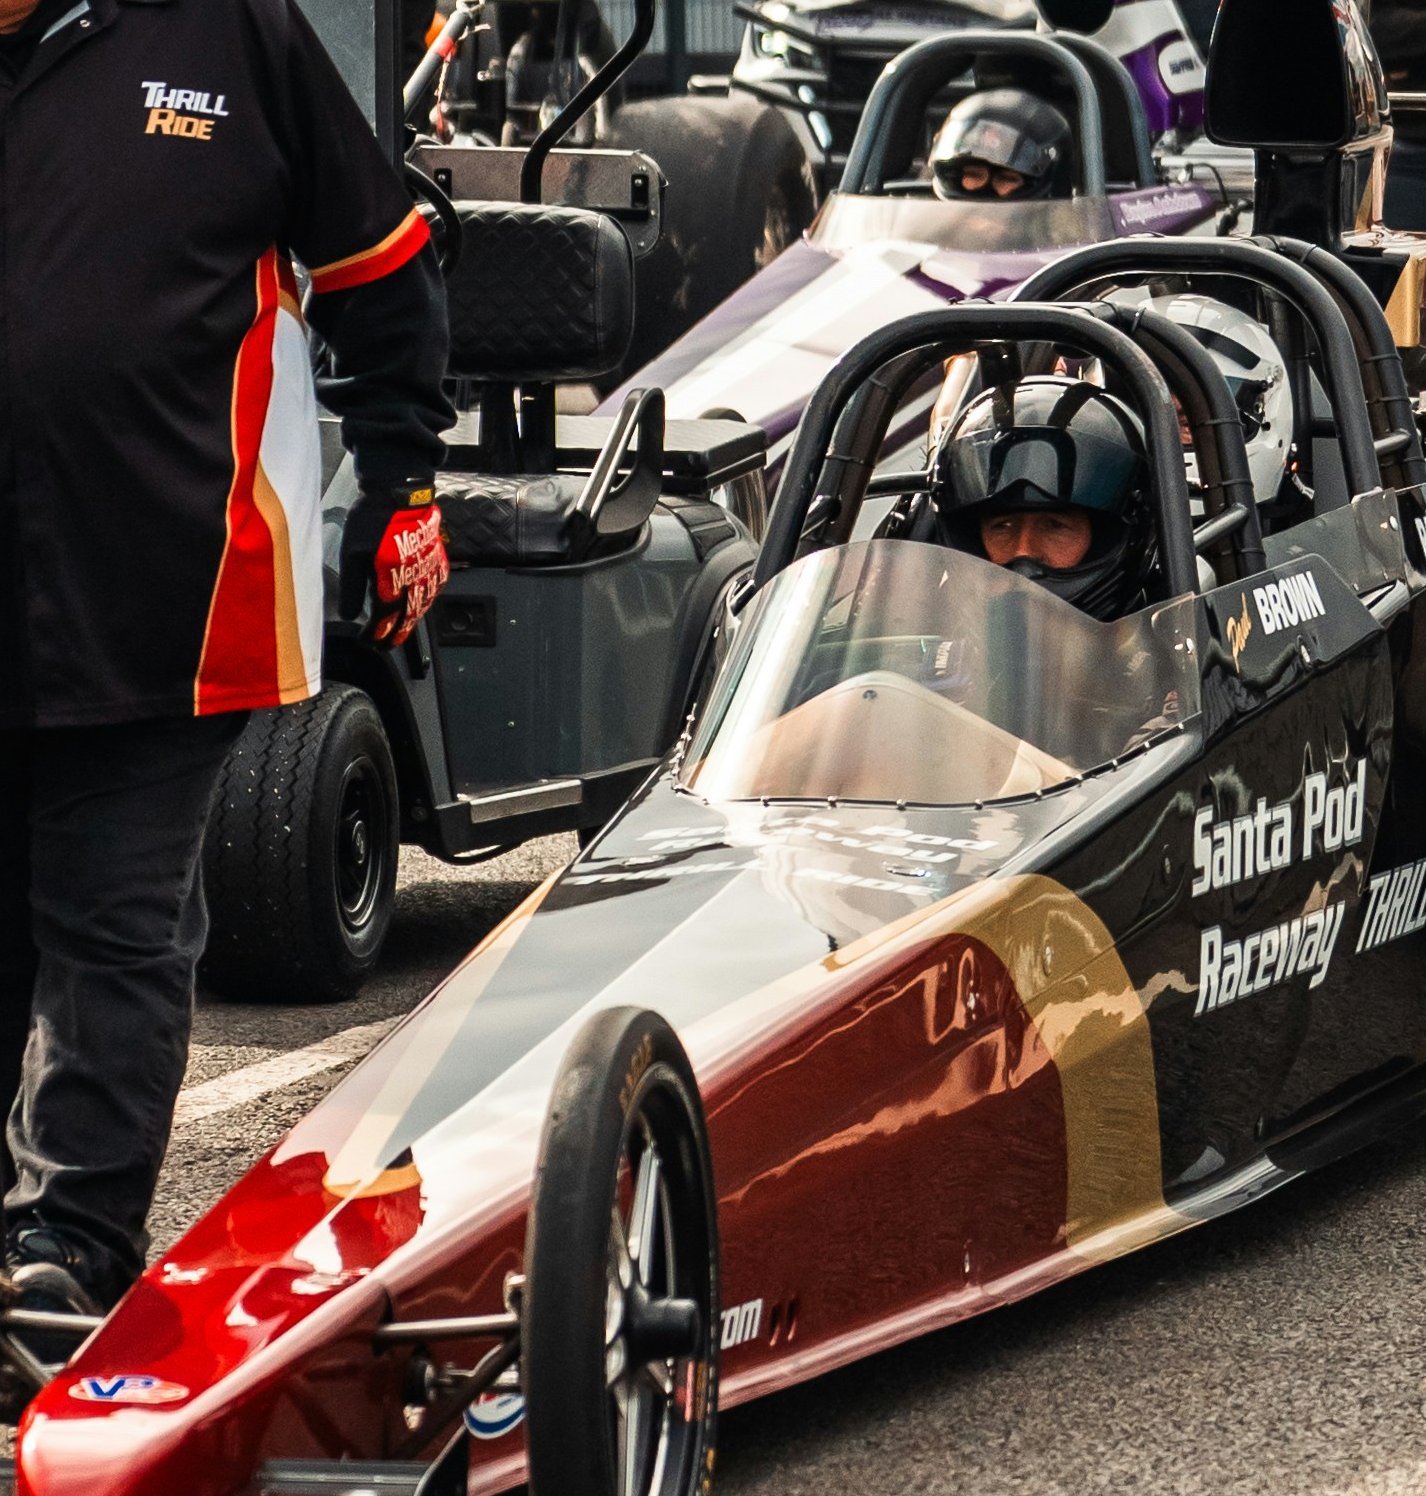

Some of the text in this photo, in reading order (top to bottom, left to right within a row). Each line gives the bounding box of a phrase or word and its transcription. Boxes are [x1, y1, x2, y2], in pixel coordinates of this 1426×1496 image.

[141, 80, 230, 116] THRILL
[1252, 570, 1326, 636] BROWN
[859, 825, 1000, 851] Pod
[1191, 757, 1368, 899] Santa Pod
[1192, 900, 1346, 1019] Raceway
